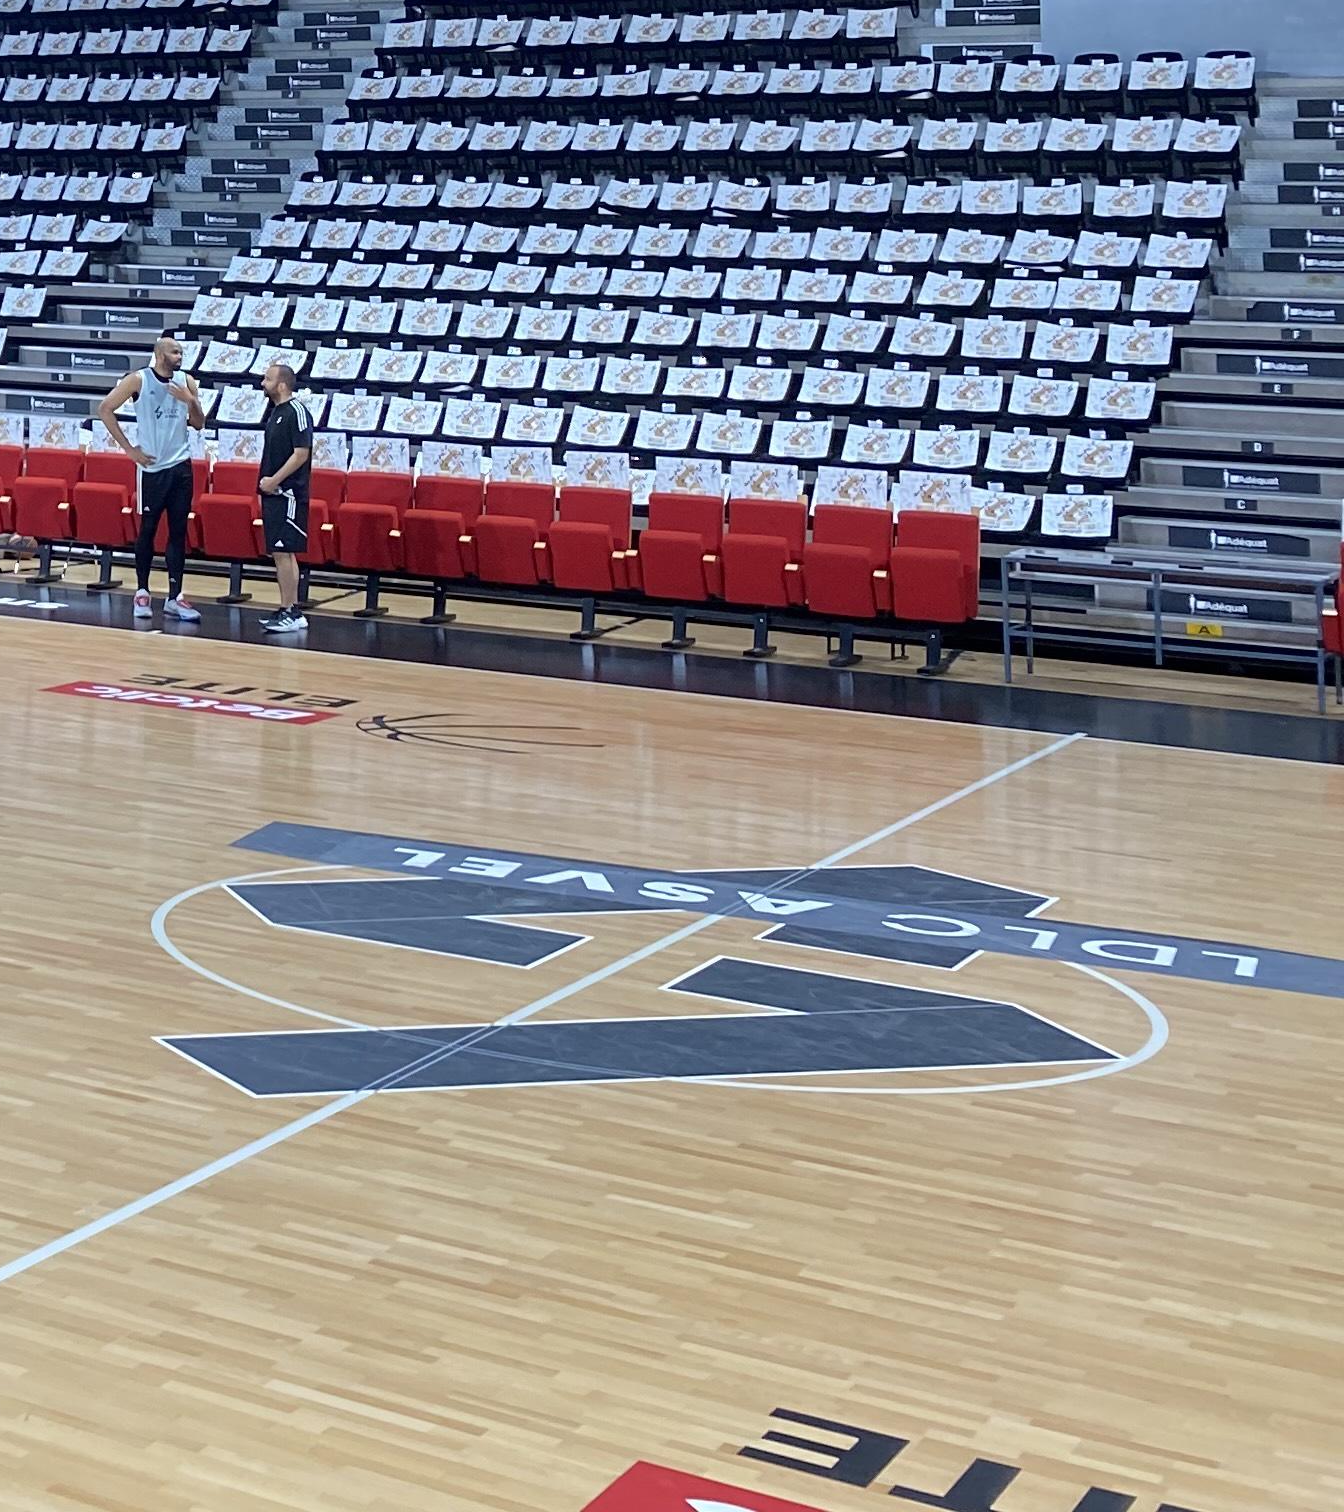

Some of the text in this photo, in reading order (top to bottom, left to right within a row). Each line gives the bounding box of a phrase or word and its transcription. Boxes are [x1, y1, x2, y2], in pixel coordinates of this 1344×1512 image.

[1198, 625, 1211, 635] A
[73, 684, 316, 721] Betclic
[120, 674, 361, 710] ELITE
[392, 844, 1261, 979] LDLC ASVEL
